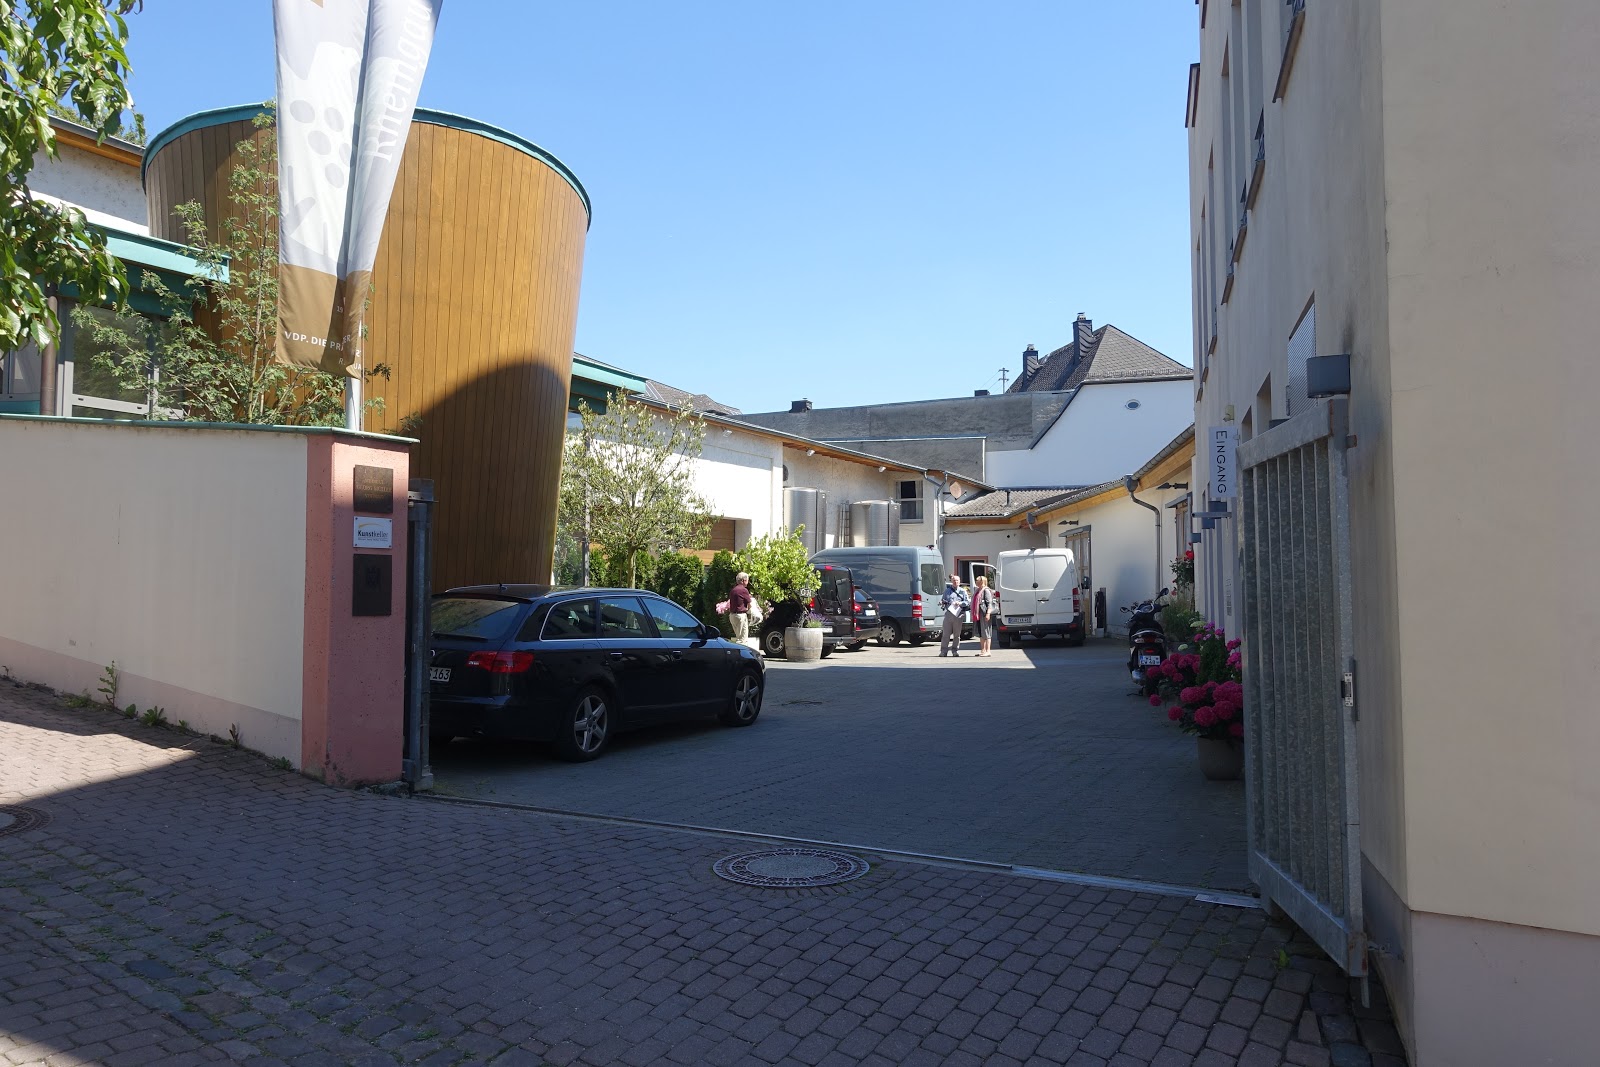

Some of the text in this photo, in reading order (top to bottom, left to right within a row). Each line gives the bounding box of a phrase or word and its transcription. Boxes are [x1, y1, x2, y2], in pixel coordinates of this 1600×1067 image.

[366, 1, 433, 163] Rheingau
[285, 330, 309, 343] VDP.
[311, 336, 328, 347] DIE
[1216, 430, 1228, 494] EINGANG
